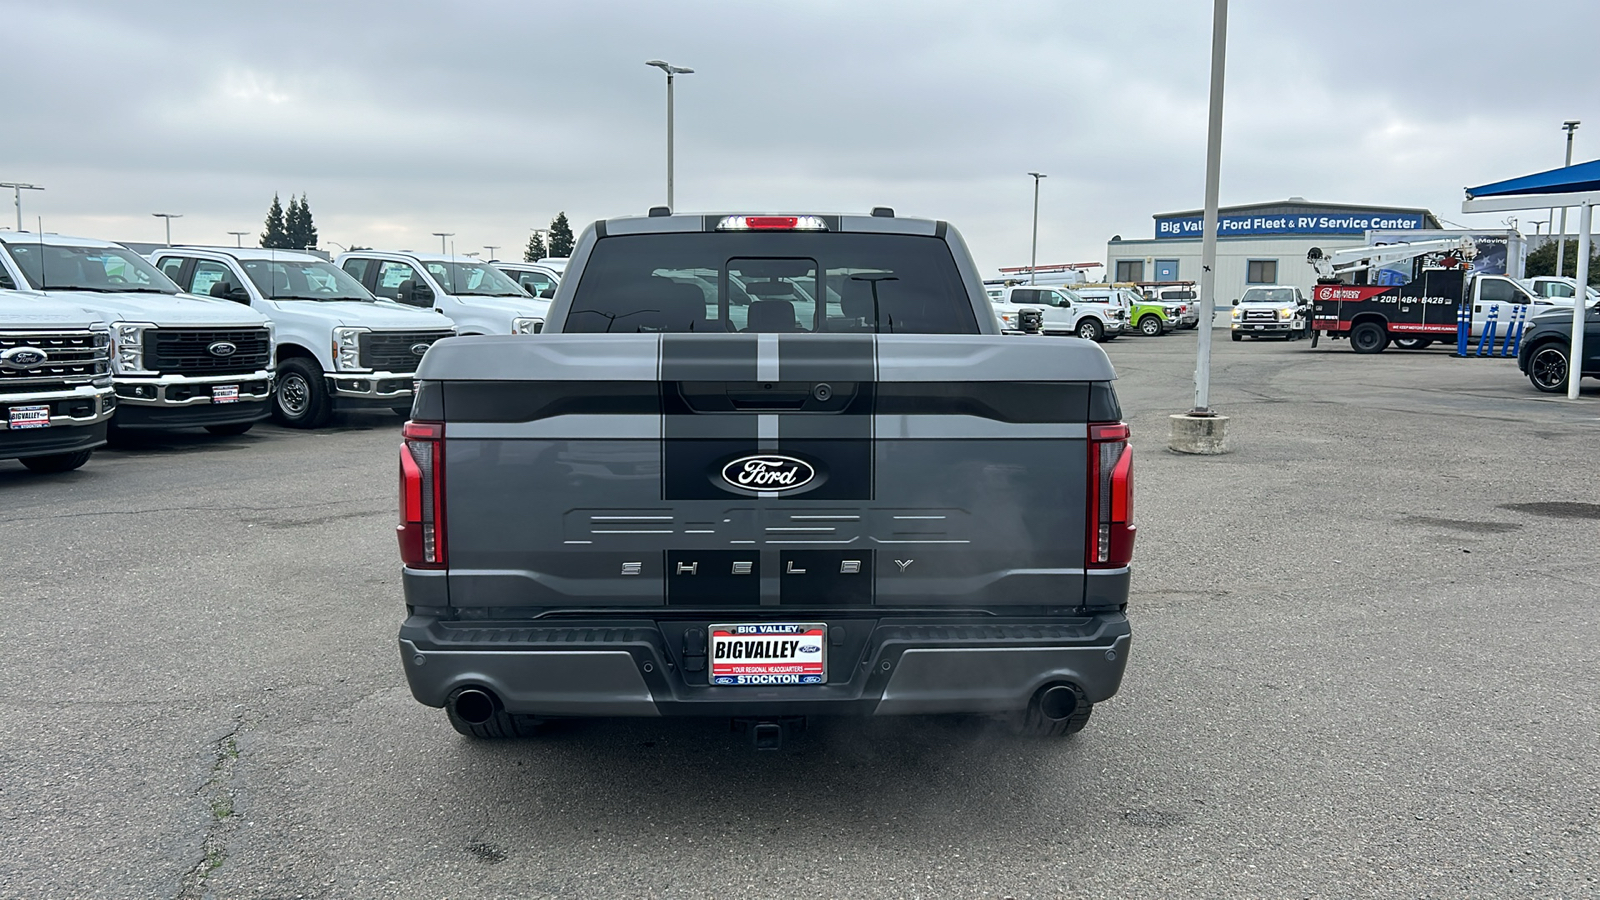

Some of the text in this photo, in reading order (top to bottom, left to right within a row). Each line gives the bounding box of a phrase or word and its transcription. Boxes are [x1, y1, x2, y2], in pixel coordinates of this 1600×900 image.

[1160, 217, 1416, 234] Big Valy Ford Fleet & RV Service Center
[16, 352, 37, 363] Ford
[12, 411, 40, 420] BIGVALLEY
[738, 460, 798, 484] Ford
[621, 560, 913, 575] SHELBY
[760, 625, 798, 633] VALLEY
[715, 641, 799, 659] BIGVALLEY
[737, 675, 799, 684] STOCKTON
